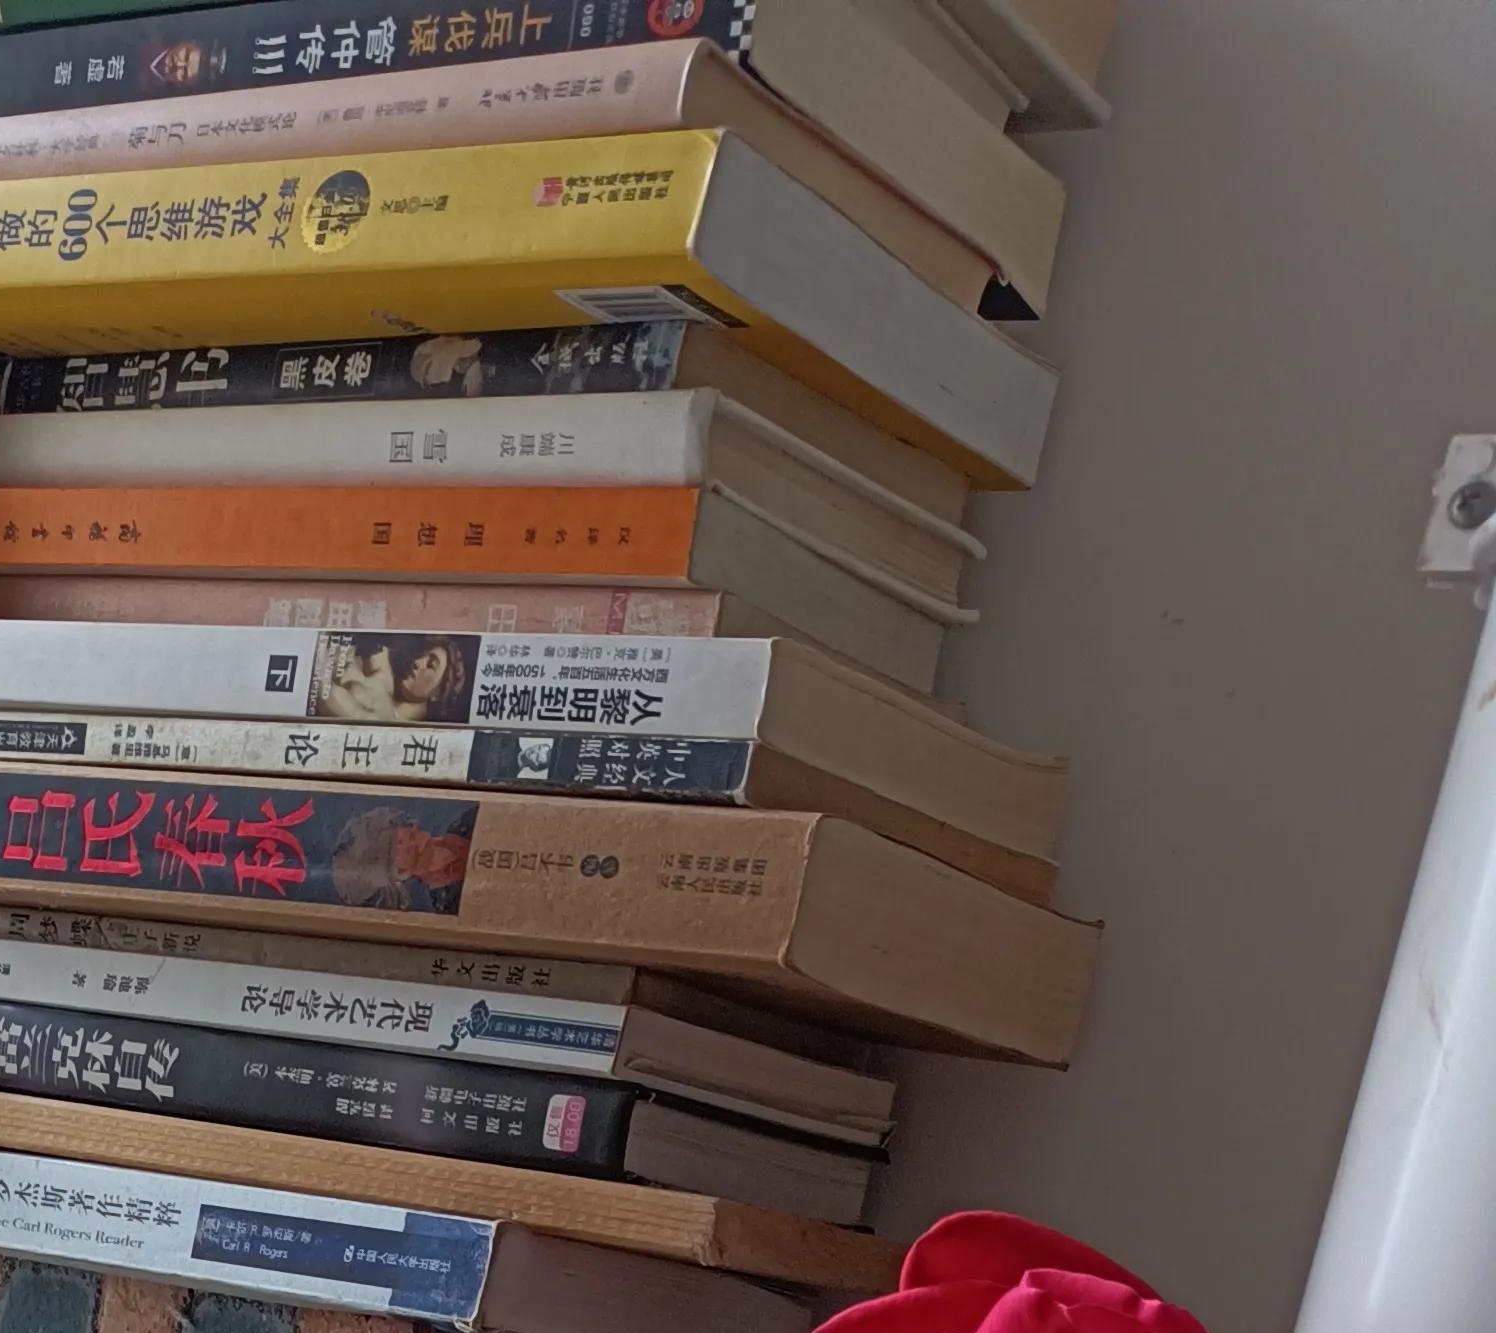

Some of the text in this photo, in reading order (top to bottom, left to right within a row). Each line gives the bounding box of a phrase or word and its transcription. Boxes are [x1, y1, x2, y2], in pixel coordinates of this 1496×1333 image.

[296, 15, 398, 74] 管仲传
[409, 11, 553, 58] 上兵伐谋
[54, 55, 125, 86] 若虚 著
[127, 121, 188, 151] 菊与刀
[269, 175, 301, 249] 大全集
[278, 349, 374, 390] 黑皮卷
[390, 428, 448, 464] 雪国
[499, 432, 576, 458] 川端康成
[373, 521, 487, 548] 理想国
[272, 659, 296, 688] 下
[477, 683, 664, 726] 从黎明到衰落
[285, 732, 439, 773] 君主论
[574, 763, 686, 787] 人文经典
[1, 788, 314, 897] 吕氏春秋
[663, 855, 768, 877] 云南出版集团
[656, 874, 763, 897] 云南人民出版社
[123, 922, 201, 952] 庄子新说
[73, 972, 151, 995] 陈池瑜 著
[431, 958, 552, 988] 华文出版社
[240, 983, 434, 1034] 现代艺术学导论
[382, 1079, 398, 1096] 著
[423, 1083, 528, 1113] 新疆电子出版社
[12, 1217, 38, 1233] Carl
[43, 1221, 89, 1242] Rogers
[356, 1249, 451, 1275] 中国人民大学出版社
